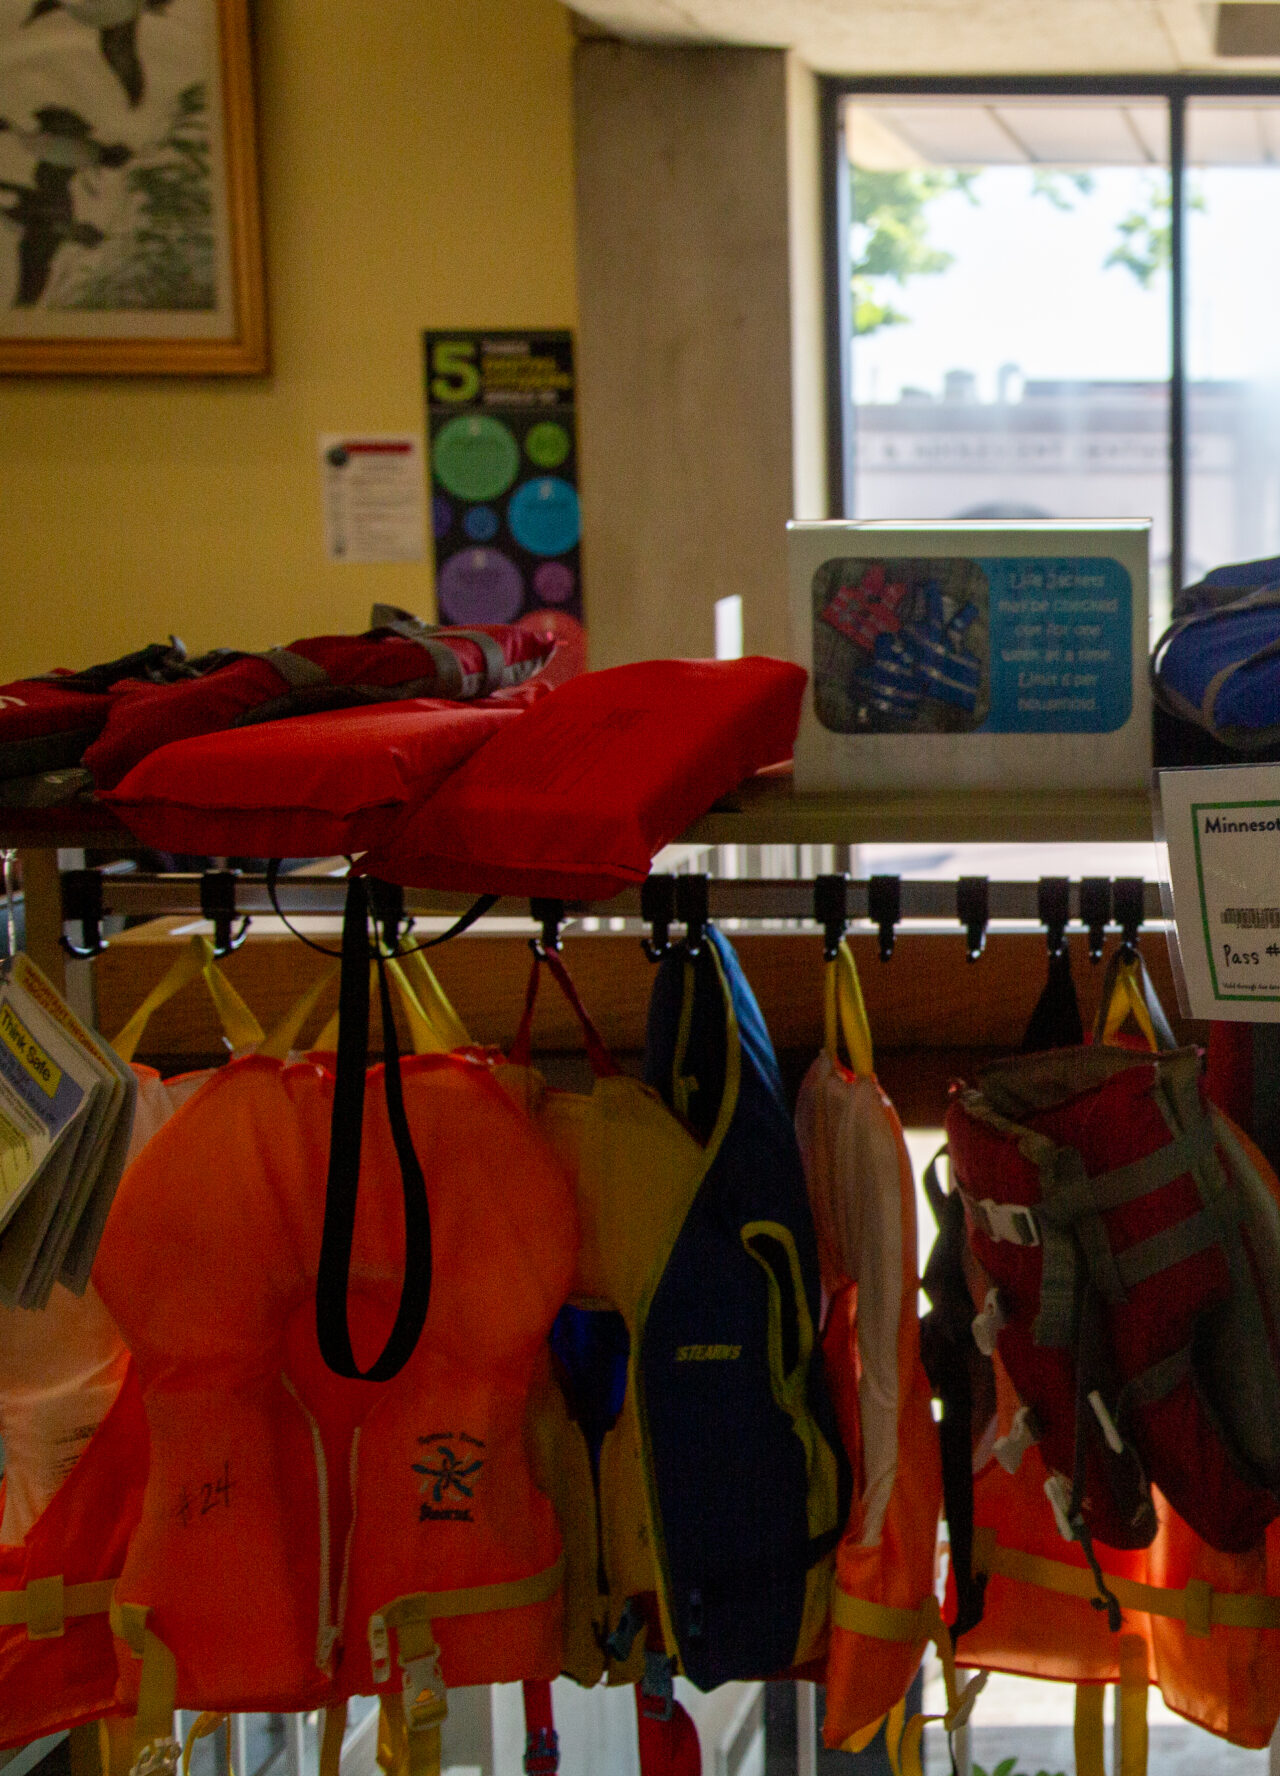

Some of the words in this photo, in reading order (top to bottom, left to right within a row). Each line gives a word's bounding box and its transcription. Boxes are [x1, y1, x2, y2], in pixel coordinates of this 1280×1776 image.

[432, 341, 479, 403] 5
[1223, 944, 1260, 967] Pass
[2, 1010, 26, 1053] Think
[27, 1046, 51, 1082] Safe
[676, 1344, 743, 1361] STEARNS
